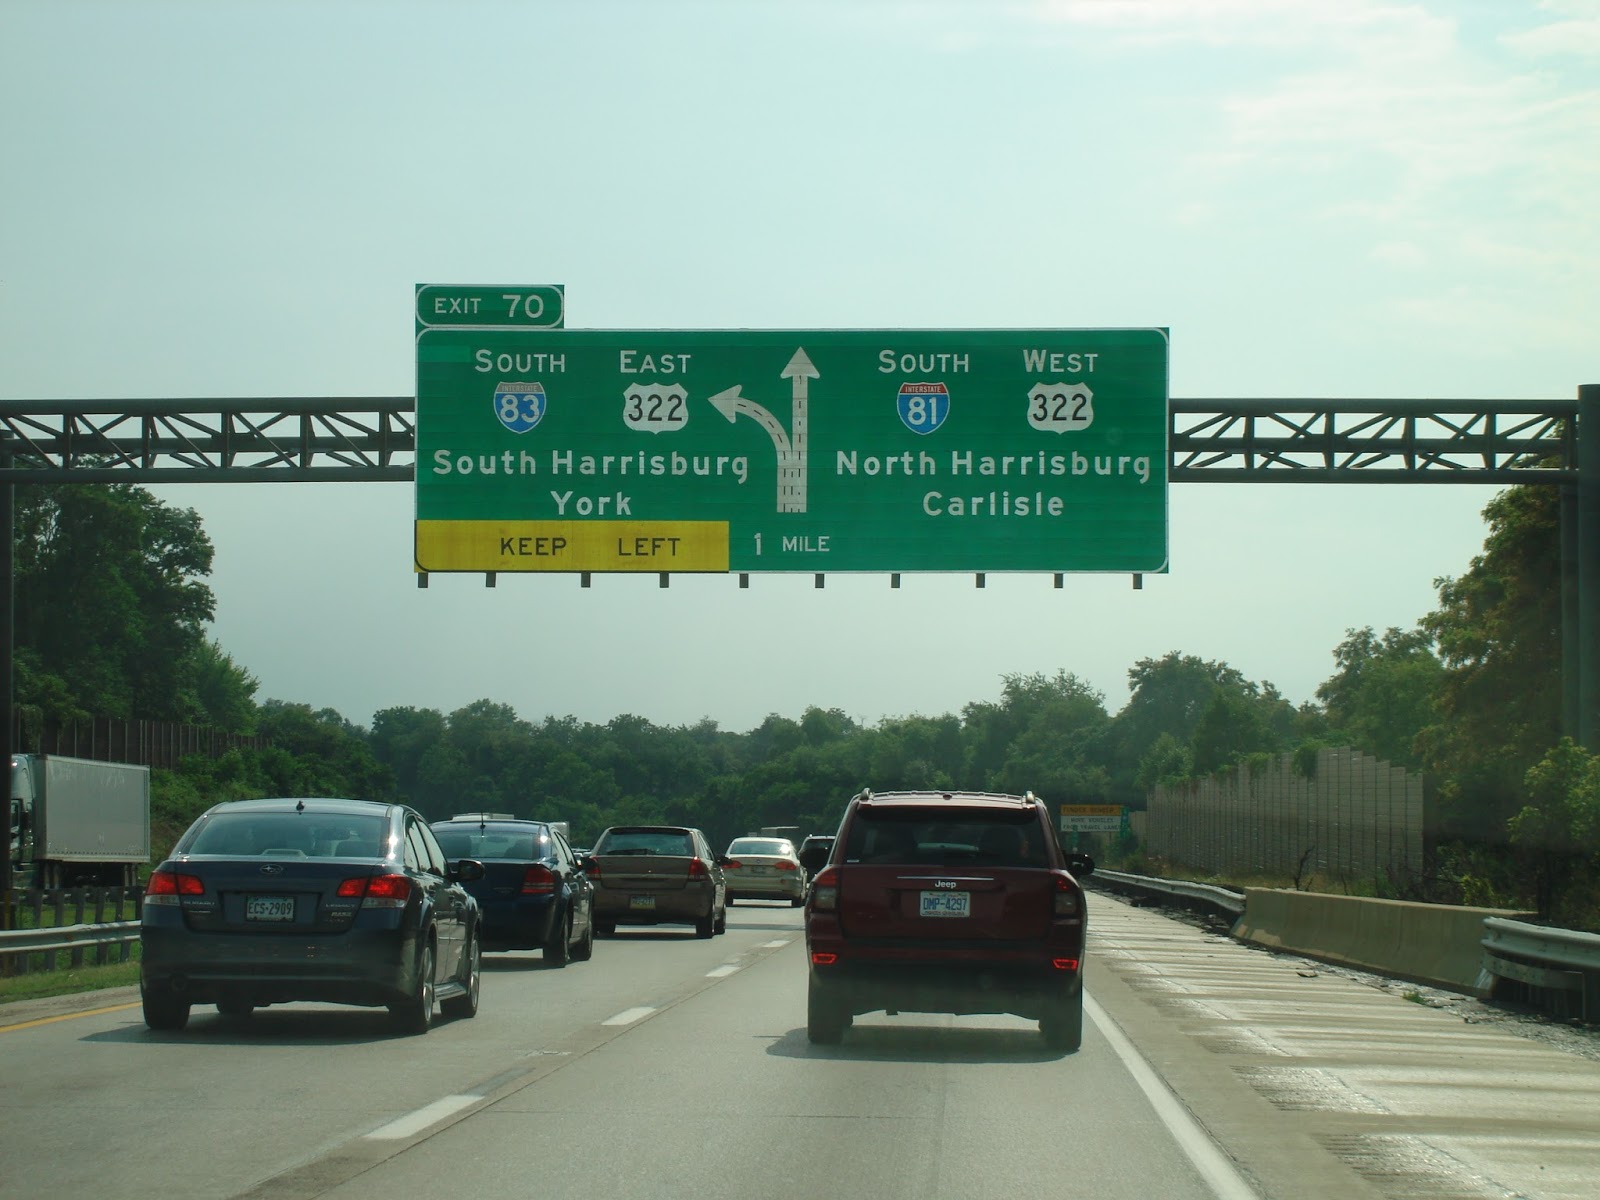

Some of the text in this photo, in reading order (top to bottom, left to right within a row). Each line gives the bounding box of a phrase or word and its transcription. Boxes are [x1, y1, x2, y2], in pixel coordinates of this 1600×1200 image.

[434, 294, 544, 319] EXIT 70
[474, 349, 565, 373] SOUTH
[620, 349, 692, 374] EAST
[878, 349, 970, 374] SOUTH
[1022, 349, 1099, 373] WEST
[501, 384, 538, 392] INTERSTATE
[905, 385, 942, 393] INTERSTATE
[500, 394, 540, 423] 83
[628, 393, 683, 422] 322
[907, 396, 937, 426] 81
[1032, 393, 1087, 422] 322
[432, 449, 748, 485] South Harrisburg
[836, 450, 1150, 484] North Harrisburg
[550, 490, 632, 516] York
[922, 490, 1064, 517] Carlisle
[500, 537, 681, 556] KEEP LEFT
[754, 532, 830, 556] 1 MILE
[934, 880, 957, 889] Jeep
[923, 897, 968, 911] DMP-4297
